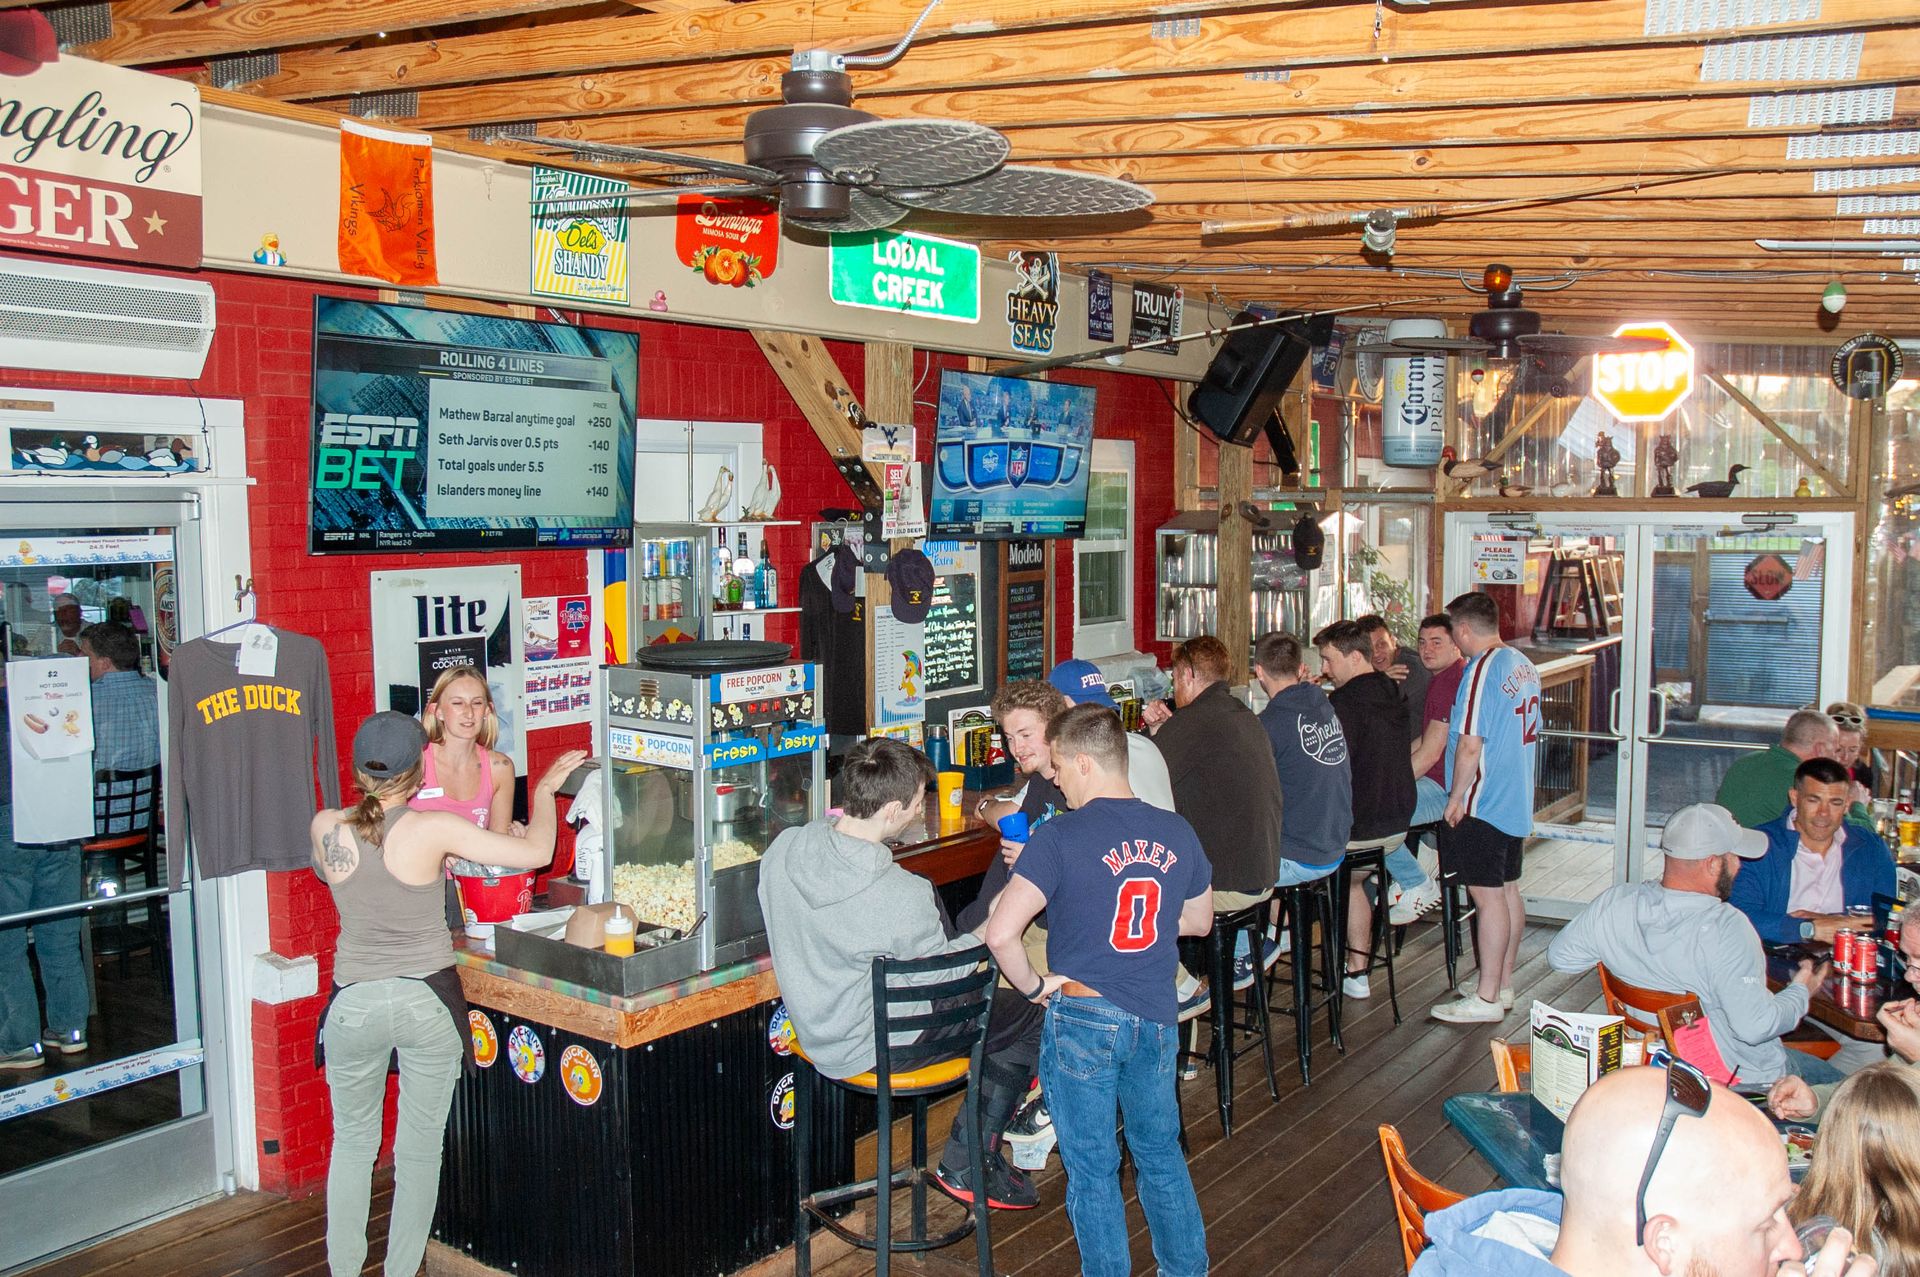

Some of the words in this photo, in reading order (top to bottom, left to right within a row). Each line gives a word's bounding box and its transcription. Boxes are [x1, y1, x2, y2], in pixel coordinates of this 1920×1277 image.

[343, 183, 366, 236] Vikings
[703, 227, 725, 238] MIMOSA
[725, 231, 740, 240] SOUR
[413, 229, 429, 270] Valley
[554, 248, 608, 280] SHANDY
[872, 236, 945, 276] LODAL
[872, 271, 945, 309] CREEK
[1096, 284, 1111, 296] BEST
[1134, 289, 1174, 318] TRULY
[1009, 296, 1057, 327] HEAVY
[1173, 301, 1181, 334] TRULY
[1014, 323, 1052, 350] SEAS
[440, 351, 495, 370] ROLLING
[497, 358, 506, 370] 4
[509, 359, 545, 373] LINES
[1599, 351, 1688, 393] STOP
[453, 371, 494, 383] SPONSORED
[495, 375, 504, 384] BY
[505, 376, 521, 385] ESPN
[1401, 349, 1432, 426] Coron
[320, 412, 419, 447] ESPN
[439, 407, 481, 421] Mathew
[483, 410, 513, 424] Barzal
[515, 413, 554, 427] anytime
[556, 415, 575, 428] goal
[587, 417, 612, 428] +250
[438, 433, 464, 446] Seth
[466, 434, 499, 447] Jarvis
[501, 438, 522, 447] over
[525, 437, 541, 448] 0.5
[543, 439, 559, 452] pts
[588, 440, 610, 451] -140
[315, 448, 416, 490] BET
[438, 458, 465, 471] Total
[468, 460, 495, 474] goals
[497, 461, 526, 472] under
[528, 461, 544, 472] 5.5
[588, 463, 608, 474] -115
[437, 484, 486, 496] Islanders
[487, 487, 522, 499] money
[523, 485, 542, 496] line
[586, 487, 609, 497] +140
[380, 531, 403, 539] Rangers
[412, 531, 436, 539] Capitals
[1009, 543, 1043, 565] Modelo
[1750, 569, 1785, 585] SLOW
[412, 594, 487, 639] lite
[48, 670, 59, 678] $2
[432, 658, 475, 670] COCKTAILS
[727, 676, 745, 689] FREE
[746, 673, 782, 686] POPCORN
[196, 687, 241, 725] THE
[242, 684, 301, 716] DUCK
[1514, 694, 1540, 746] 12
[611, 733, 633, 746] FREE
[647, 739, 691, 755] POPCORN
[713, 744, 758, 762] Fresh
[1102, 839, 1178, 876] MAXEY
[1109, 876, 1161, 953] 0
[483, 1018, 496, 1041] INN
[510, 1028, 530, 1046] DUCK
[530, 1036, 544, 1058] INN
[562, 1047, 584, 1068] DUCK
[585, 1054, 600, 1079] INN
[773, 1074, 794, 1105] DUCK
